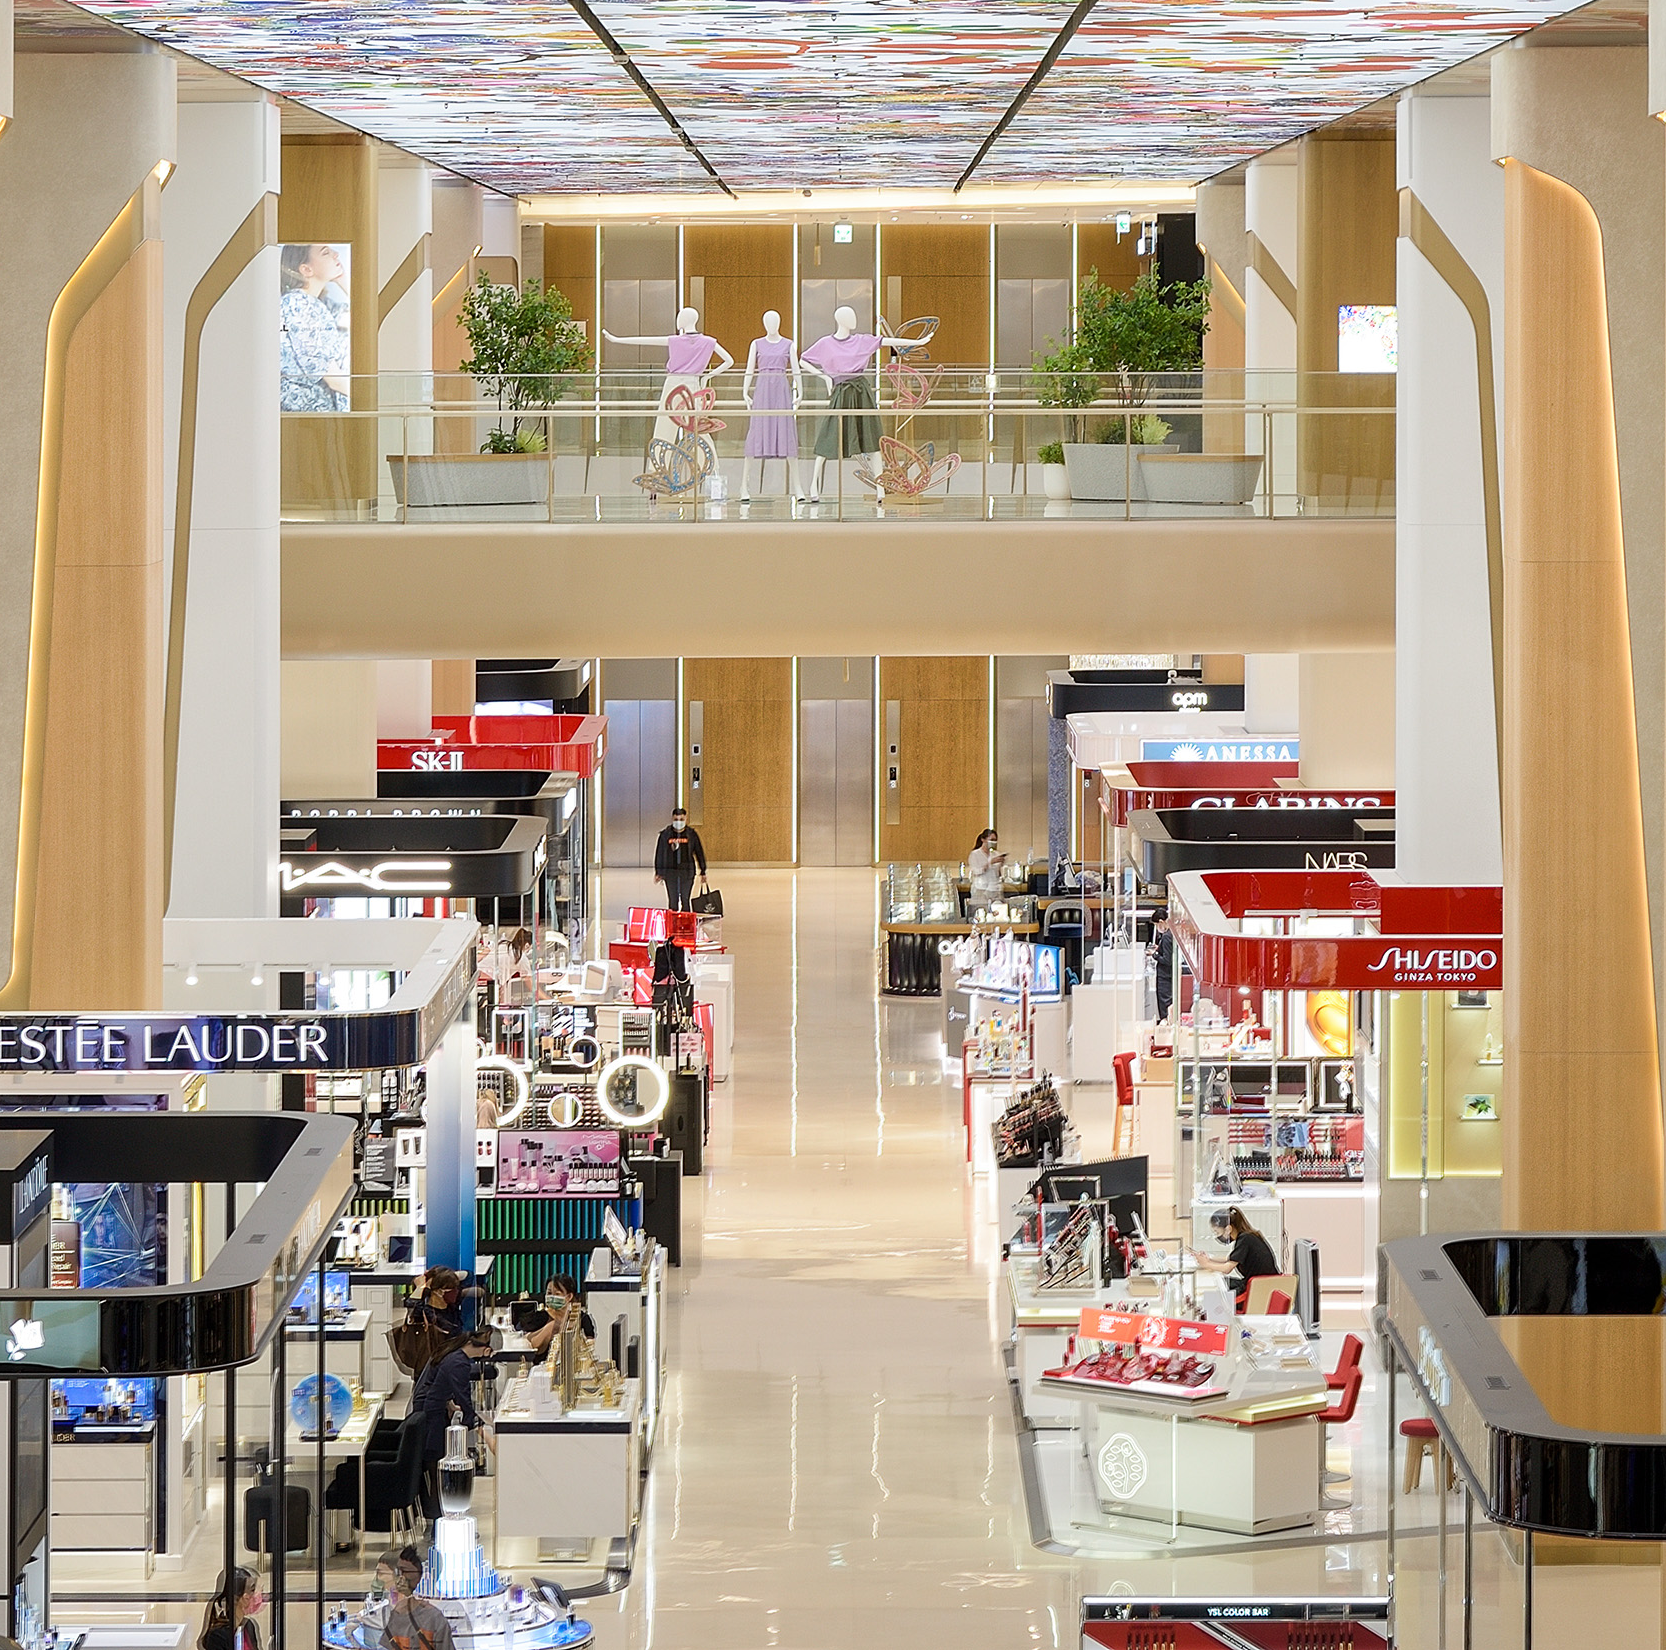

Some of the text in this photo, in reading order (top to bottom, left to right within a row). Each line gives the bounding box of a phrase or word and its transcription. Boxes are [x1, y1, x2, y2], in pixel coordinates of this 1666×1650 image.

[411, 751, 465, 771] SK-II
[1205, 745, 1292, 760] ANESSA
[1366, 947, 1497, 971] SHISEIDO
[1394, 972, 1477, 982] GINZA TOKYO
[143, 1024, 329, 1063] LAUDER
[1207, 1607, 1269, 1617] YSL COLOR BAR
